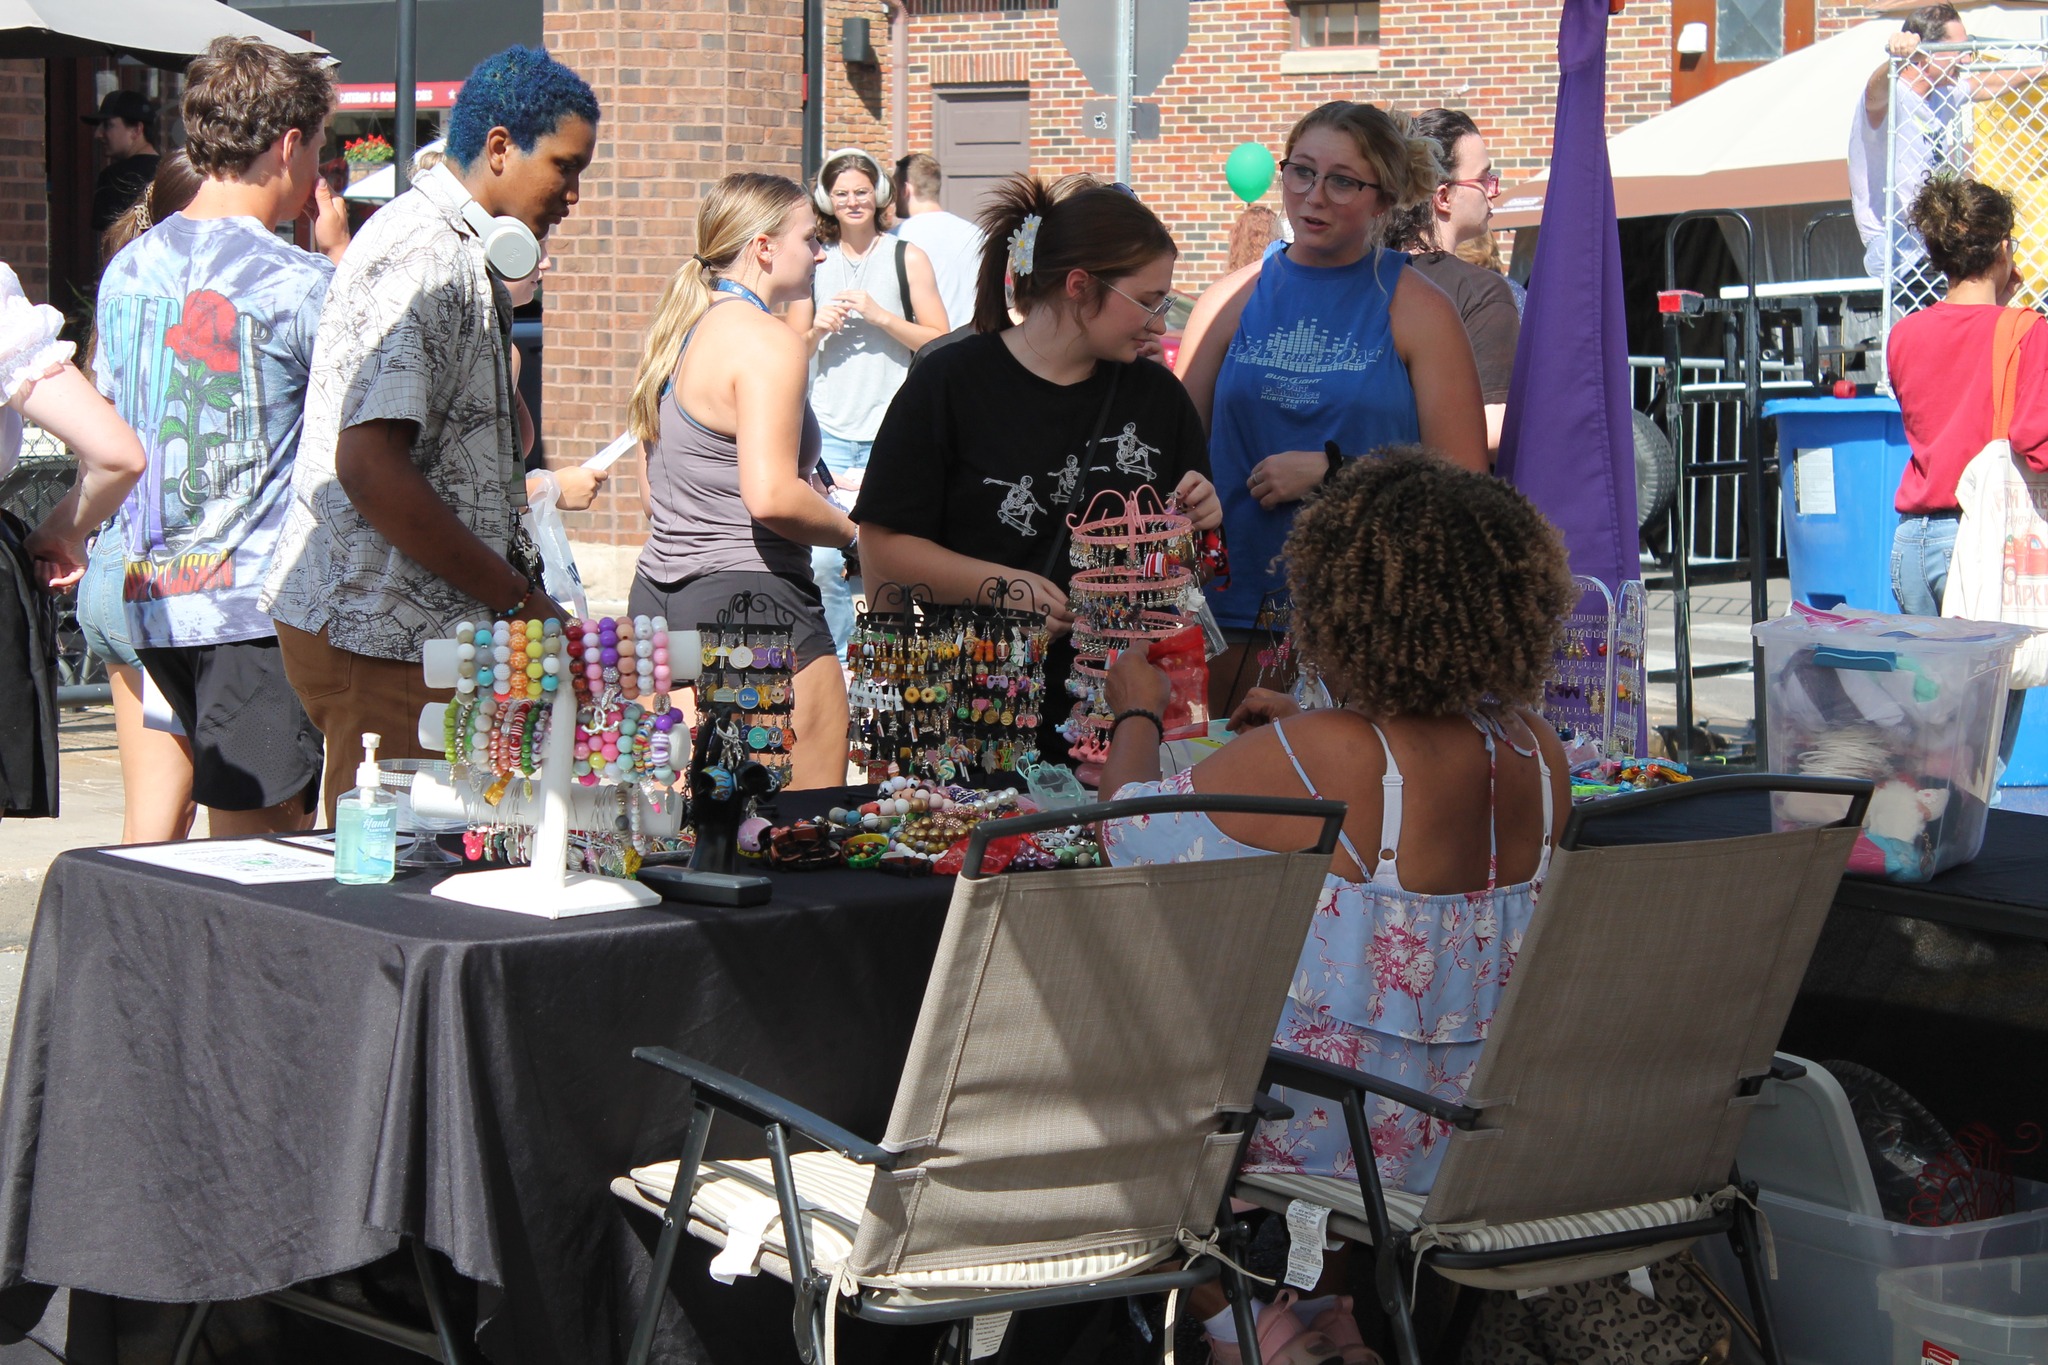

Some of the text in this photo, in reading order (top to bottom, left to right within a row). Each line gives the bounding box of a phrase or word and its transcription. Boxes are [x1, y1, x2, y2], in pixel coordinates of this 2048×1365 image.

[1265, 372, 1289, 382] BUD
[1260, 394, 1285, 402] MUSIC
[1280, 402, 1298, 410] 2012
[363, 818, 391, 830] Hand
